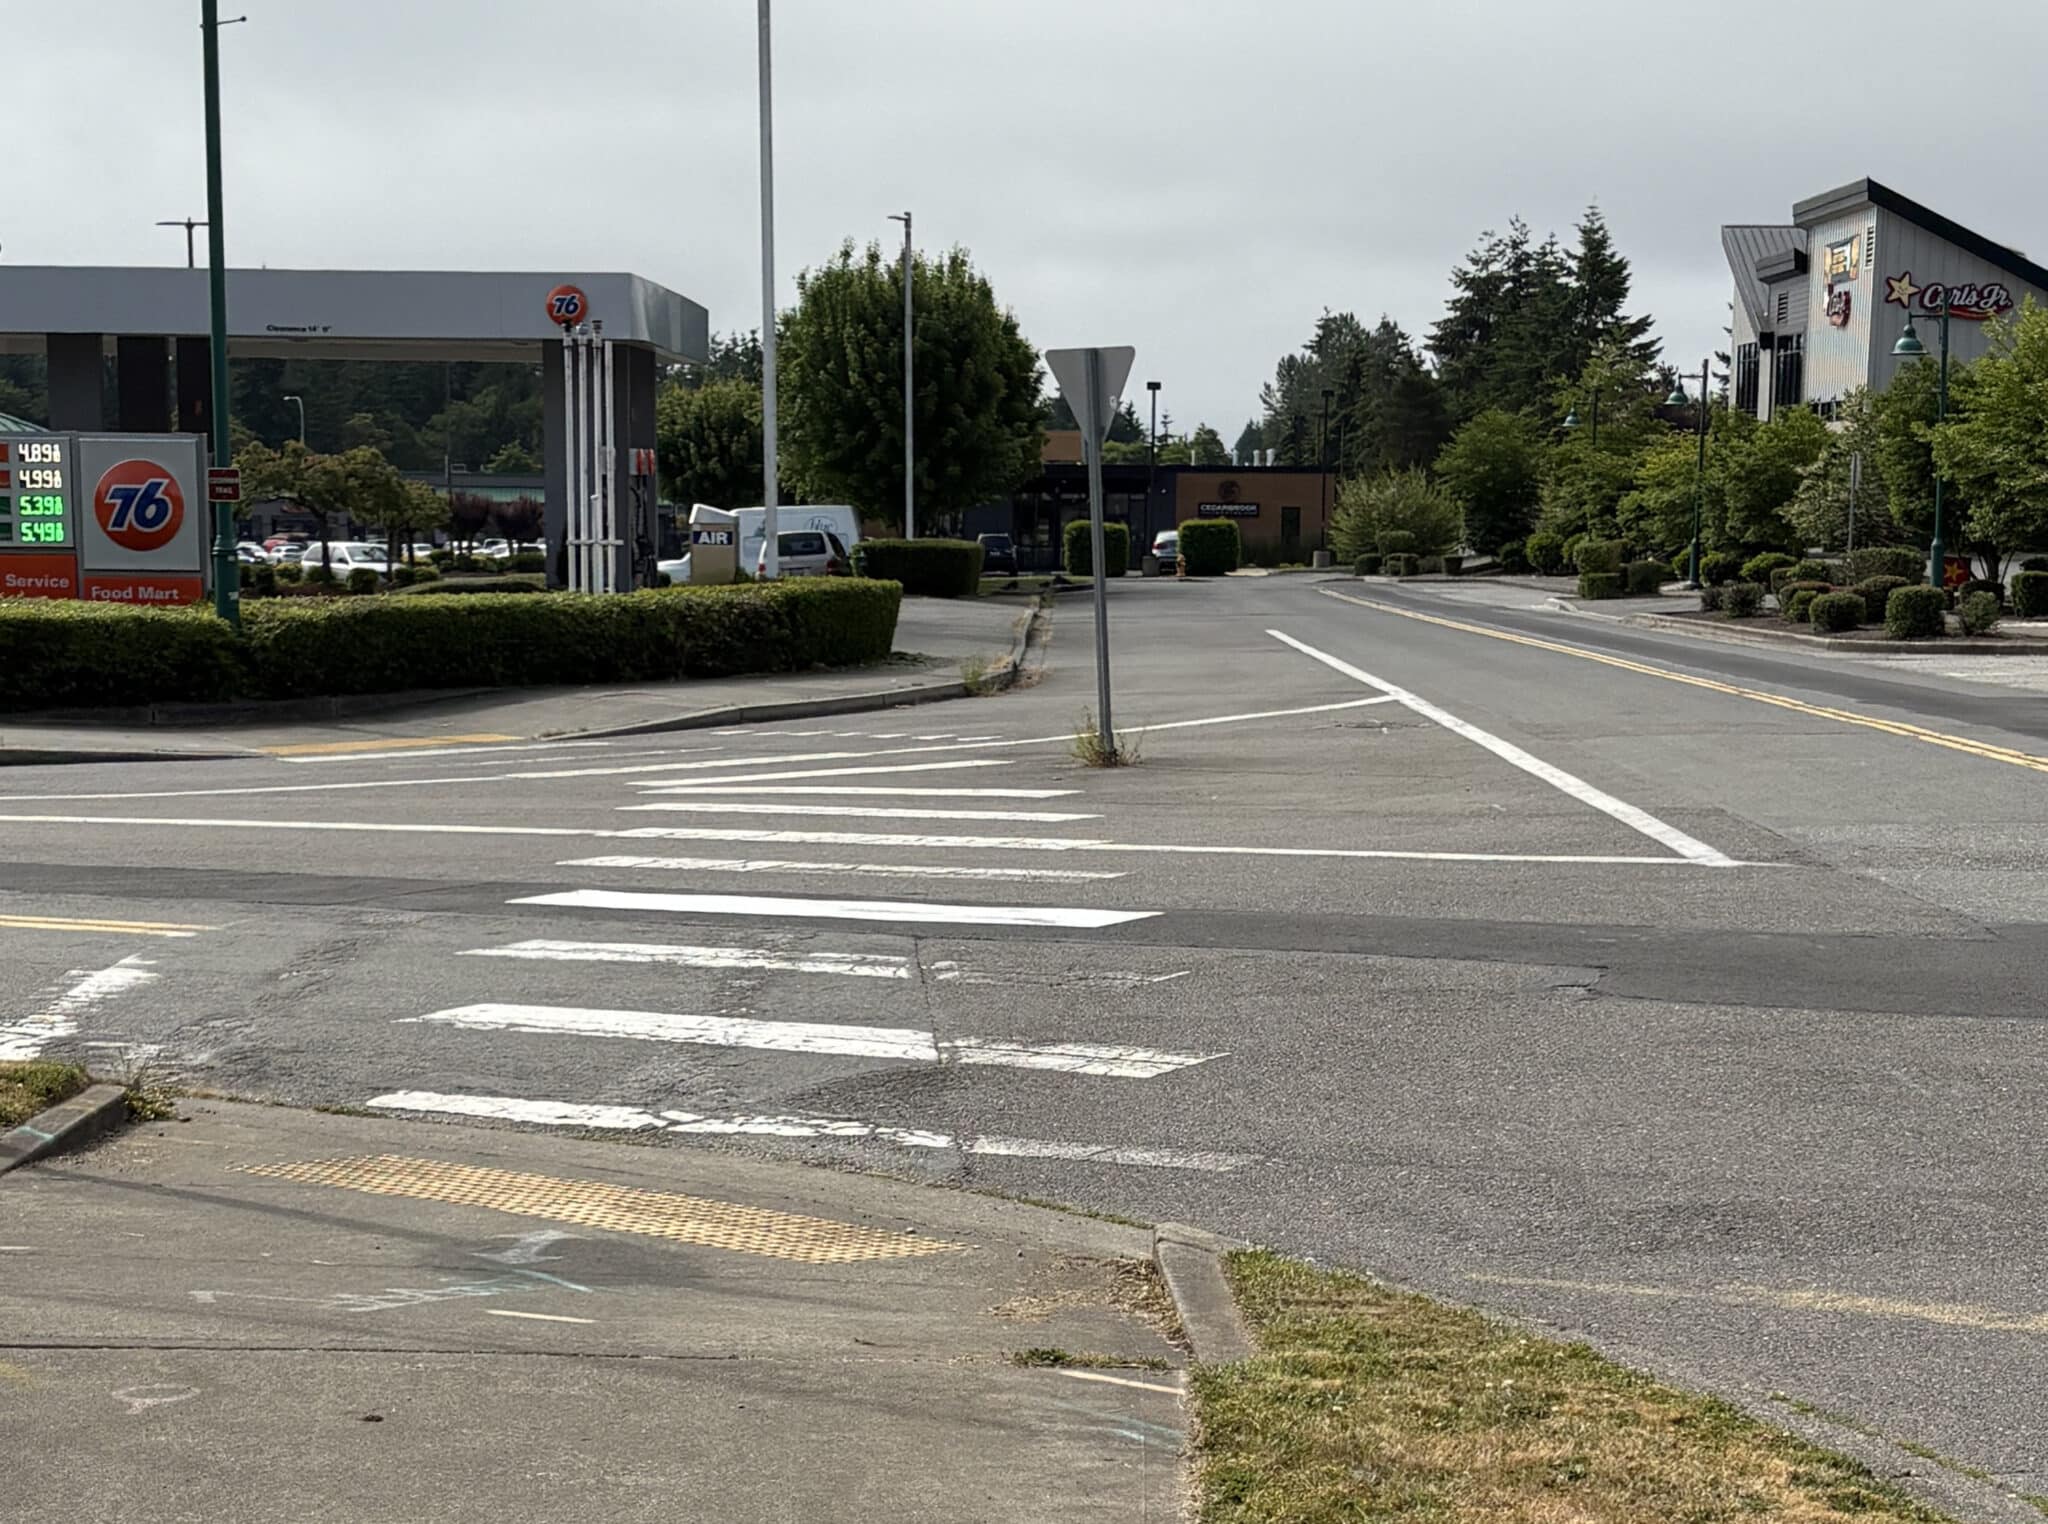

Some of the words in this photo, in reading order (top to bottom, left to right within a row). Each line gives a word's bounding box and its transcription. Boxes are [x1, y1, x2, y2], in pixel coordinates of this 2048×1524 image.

[552, 294, 581, 317] 76
[1980, 285, 2013, 308] Jr.
[104, 478, 172, 533] 76
[698, 531, 728, 544] AIR
[5, 574, 70, 589] Service
[91, 586, 133, 600] Food
[138, 587, 179, 600] Mart
